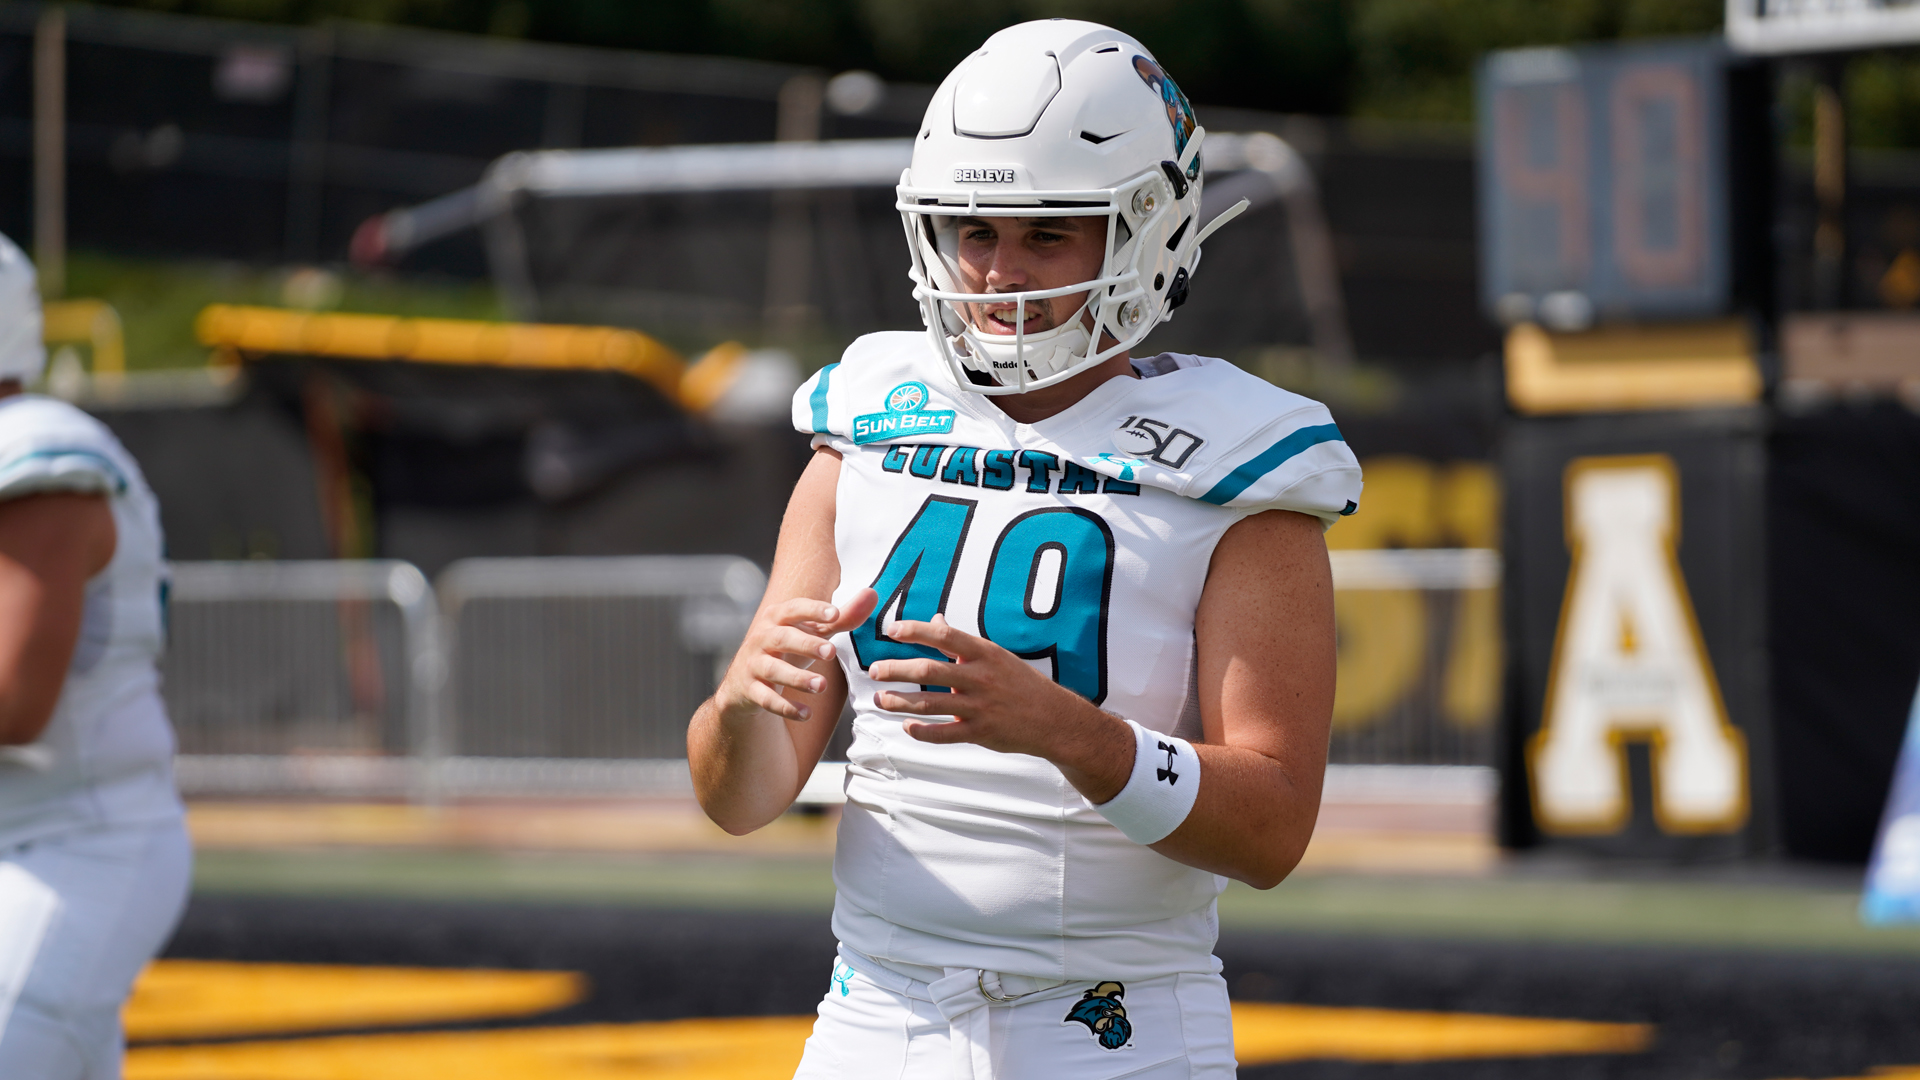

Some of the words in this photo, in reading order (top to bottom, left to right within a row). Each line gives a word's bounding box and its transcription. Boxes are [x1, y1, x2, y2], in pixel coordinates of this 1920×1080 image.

[1497, 66, 1705, 285] 40
[856, 419, 897, 437] SUN
[900, 414, 951, 429] BELT
[1117, 415, 1204, 470] 150
[849, 493, 1116, 707] 49
[1523, 452, 1751, 836] A
